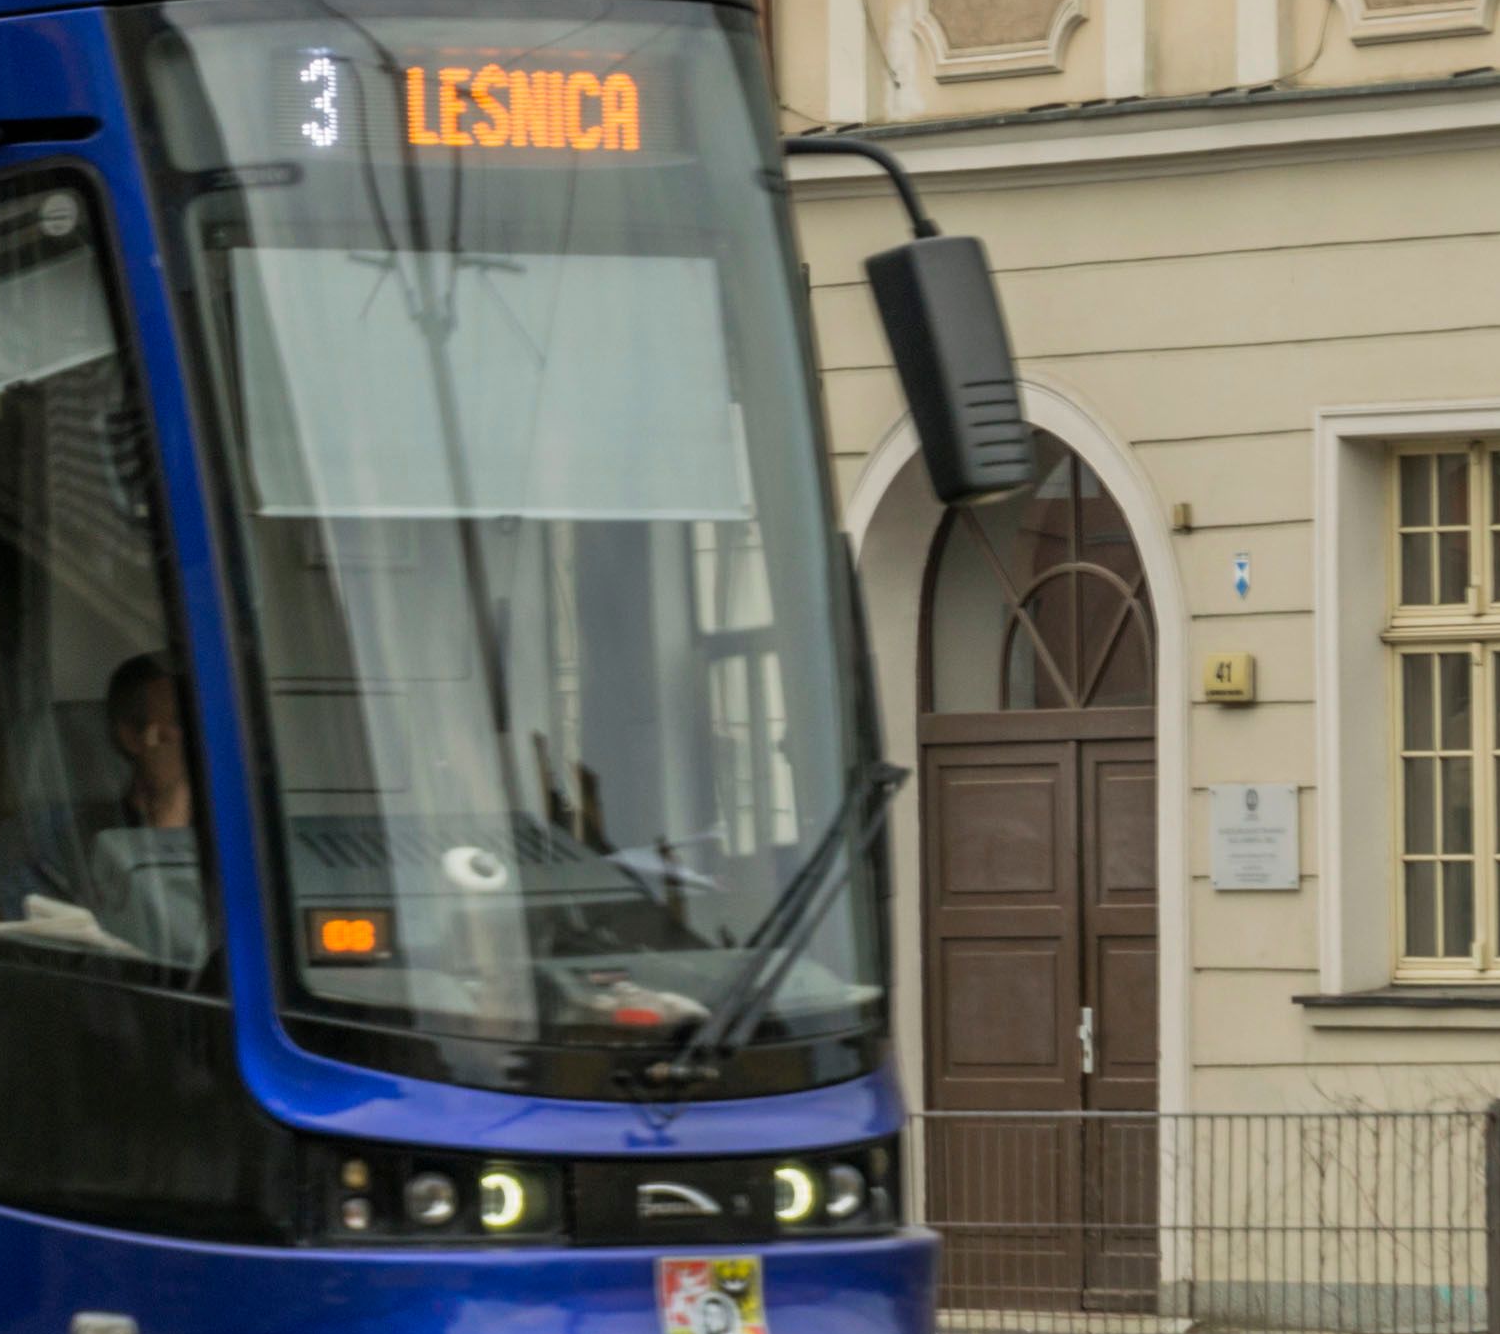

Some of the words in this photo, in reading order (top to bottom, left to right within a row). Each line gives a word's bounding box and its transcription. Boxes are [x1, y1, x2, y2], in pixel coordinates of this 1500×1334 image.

[299, 57, 338, 147] 3
[406, 63, 641, 150] LEŚNICA
[1215, 660, 1233, 684] 41
